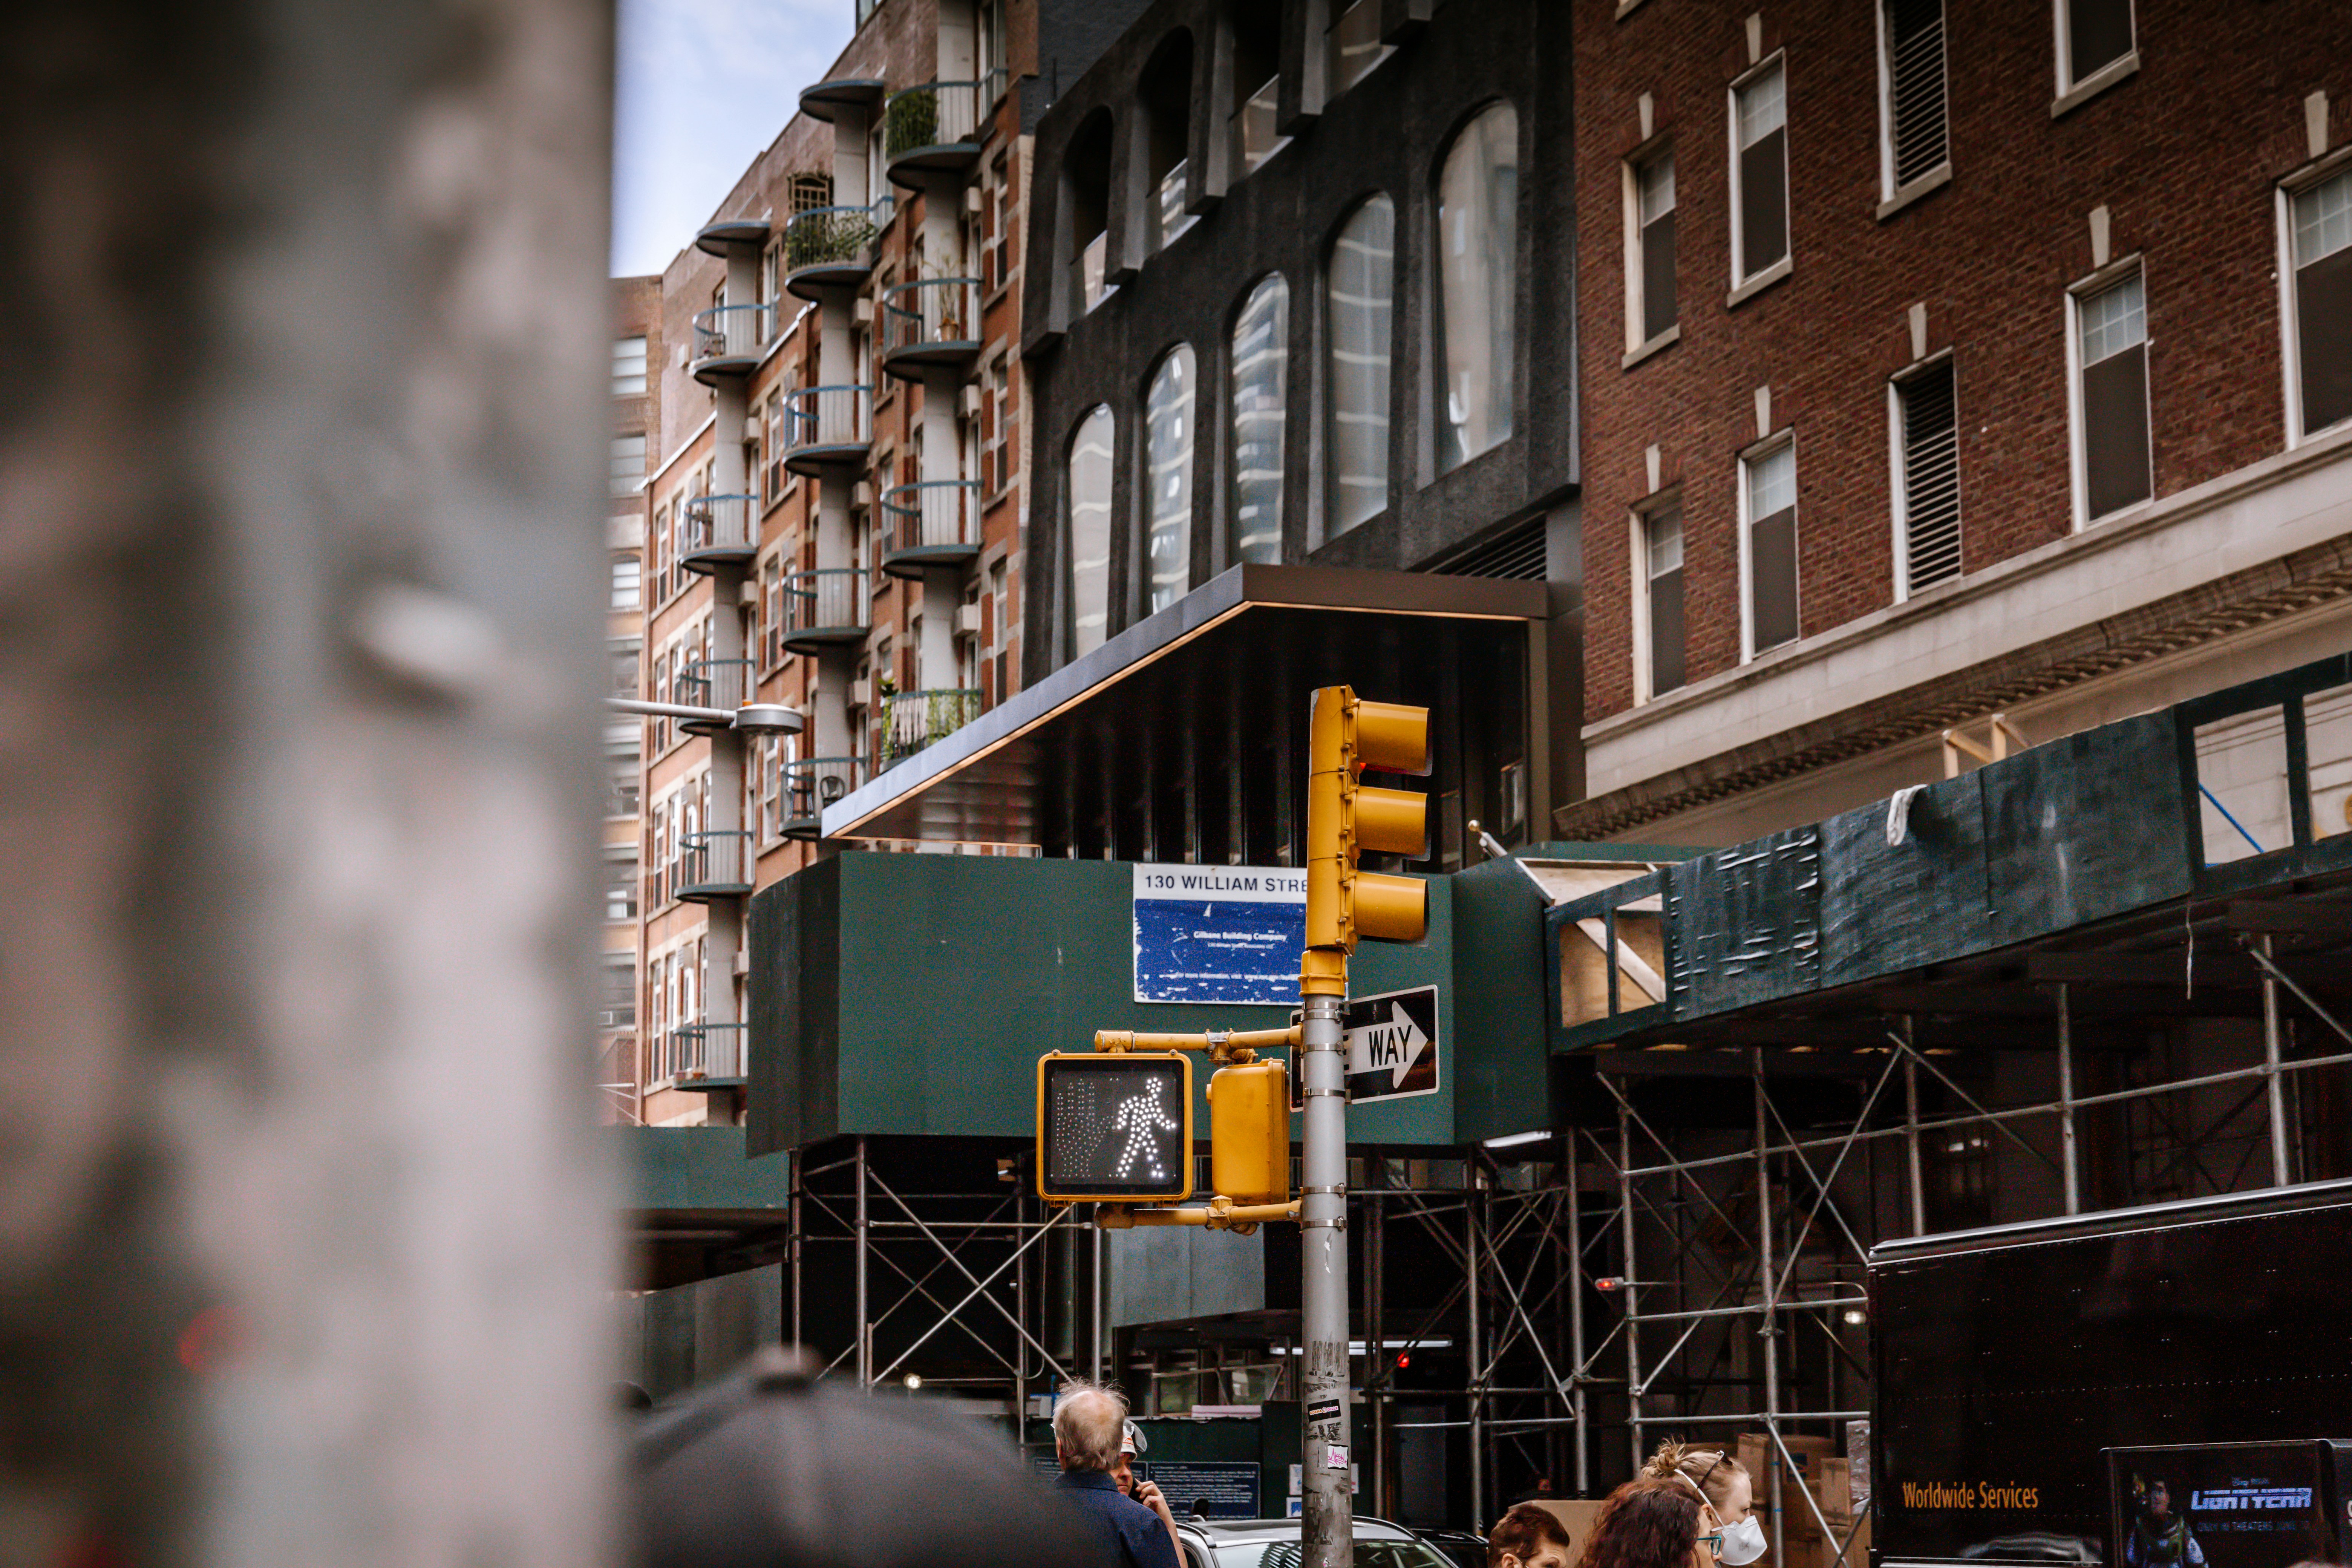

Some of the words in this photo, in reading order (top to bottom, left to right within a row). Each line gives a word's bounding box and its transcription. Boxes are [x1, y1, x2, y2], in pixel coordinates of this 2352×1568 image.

[1145, 875, 1174, 888] 130
[1182, 876, 1257, 891] WILLIAM
[1369, 1024, 1412, 1067] WAY
[1903, 1481, 1975, 1508] Worldwide
[1979, 1481, 2039, 1508] Services
